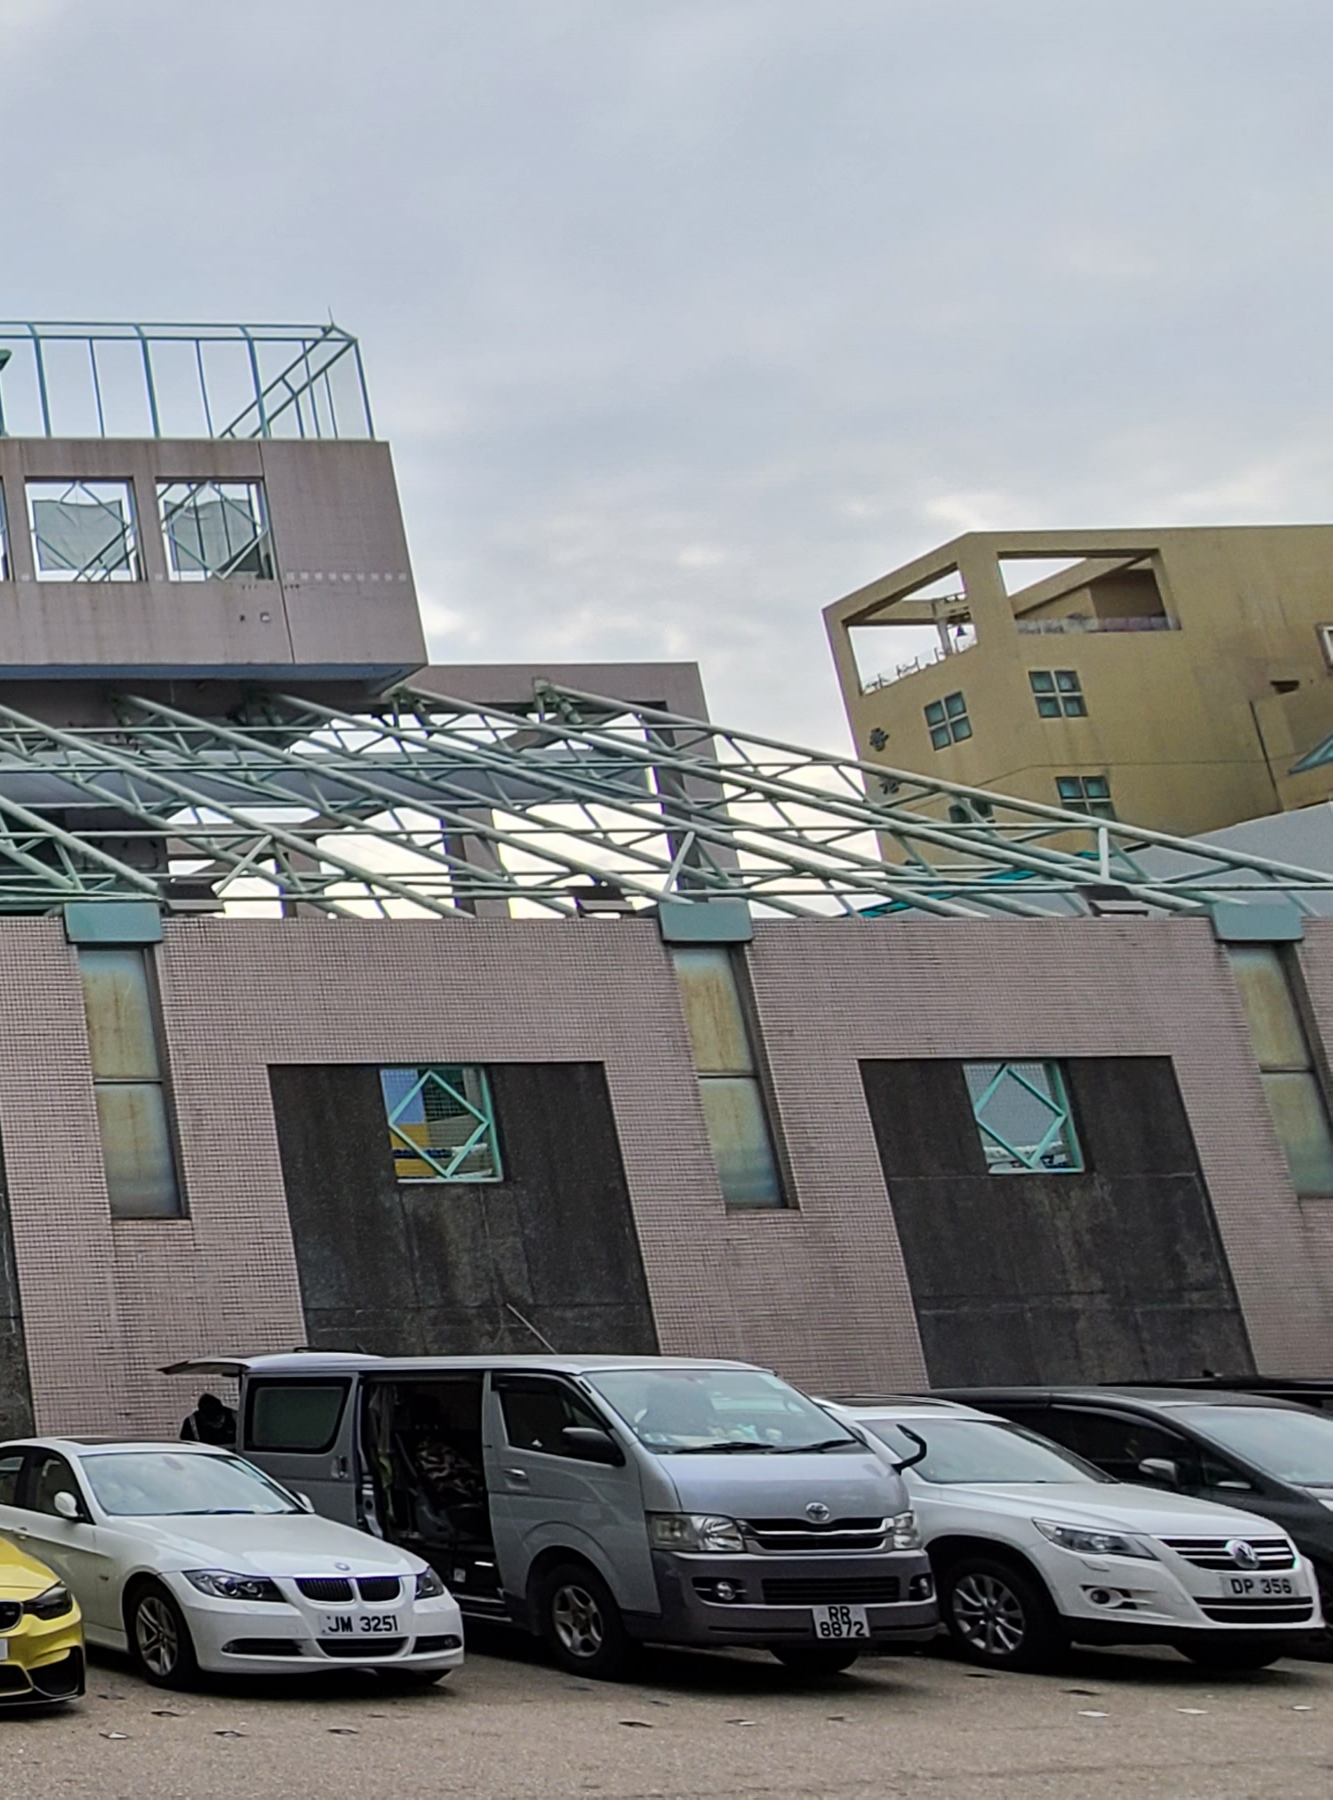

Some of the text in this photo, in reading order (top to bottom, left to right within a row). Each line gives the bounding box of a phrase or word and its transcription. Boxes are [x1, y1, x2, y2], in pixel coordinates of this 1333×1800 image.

[1230, 1578, 1292, 1595] DP 356
[827, 1605, 852, 1622] RR
[328, 1614, 398, 1633] JM 3251
[819, 1621, 866, 1637] 8872
